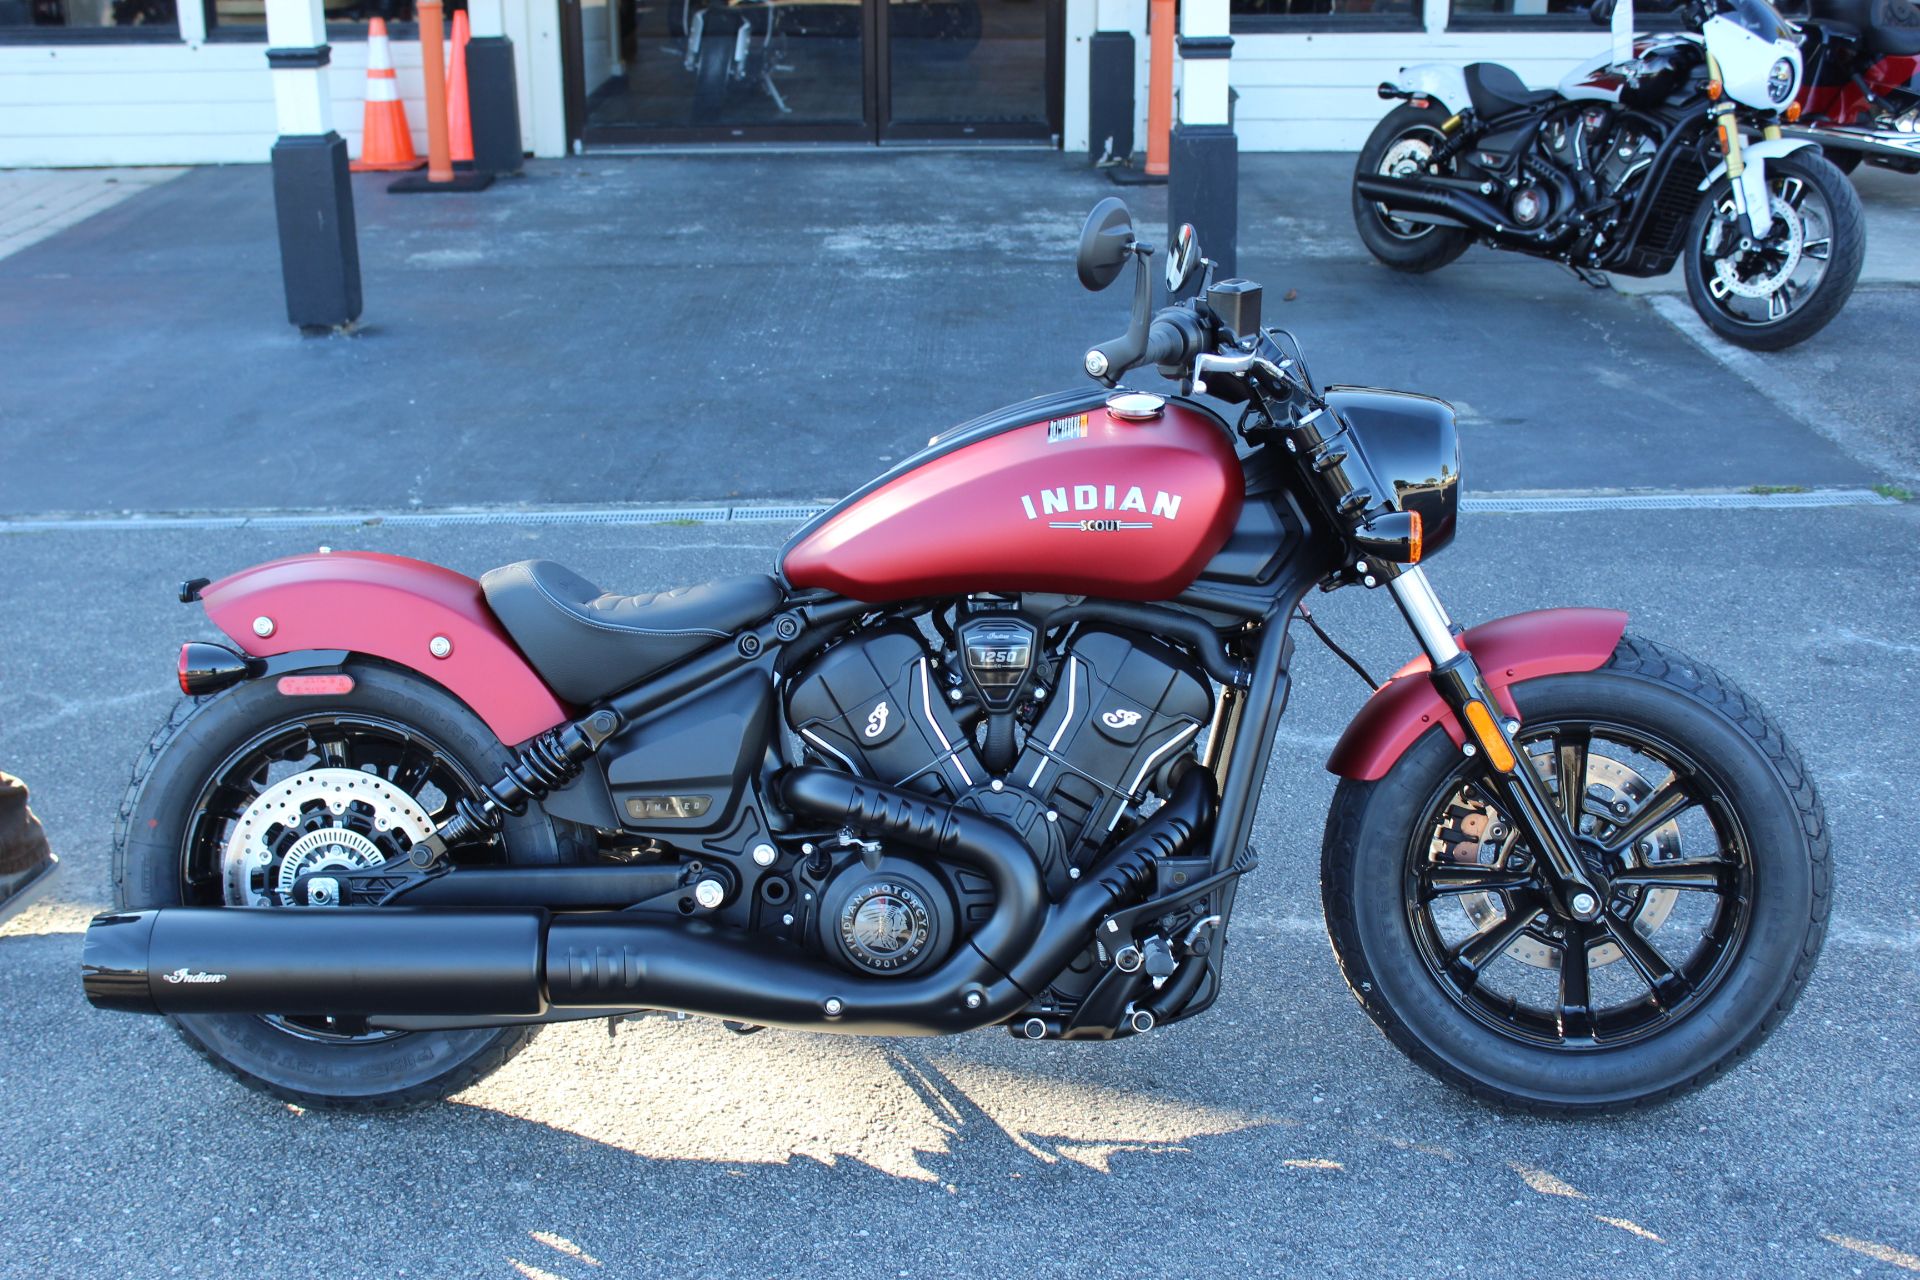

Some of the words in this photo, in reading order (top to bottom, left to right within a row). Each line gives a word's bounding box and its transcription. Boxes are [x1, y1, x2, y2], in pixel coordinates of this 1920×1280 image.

[1020, 484, 1182, 520] INDIAN
[1080, 520, 1121, 531] SCOUT
[980, 651, 1017, 663] 1250
[635, 802, 700, 812] LIMIED
[842, 894, 865, 950] INDIAN
[868, 884, 928, 955] MOTORCYCLE
[866, 957, 898, 968] 1901
[163, 968, 227, 984] Indian
